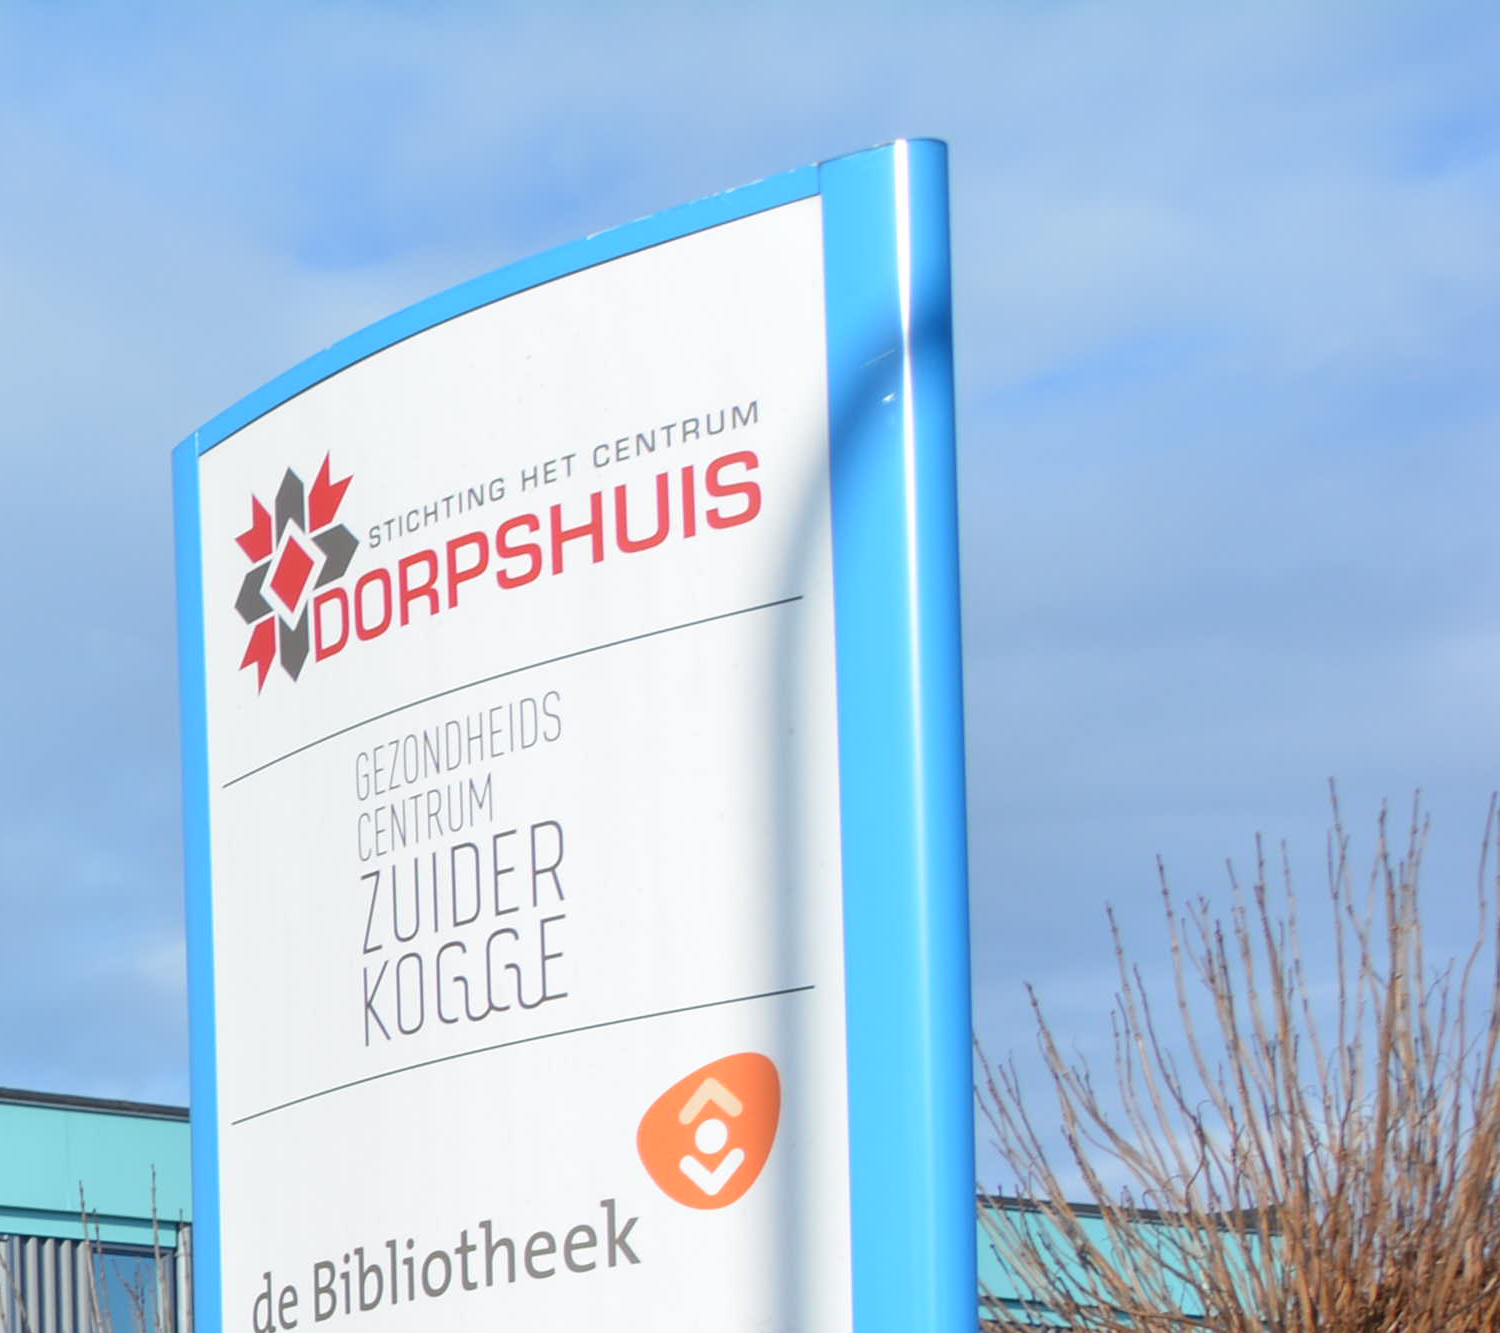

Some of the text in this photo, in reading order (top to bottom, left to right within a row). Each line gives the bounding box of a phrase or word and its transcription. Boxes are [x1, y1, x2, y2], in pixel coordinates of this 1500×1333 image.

[368, 400, 760, 549] STICHTING HET CENTRUM
[313, 449, 763, 662] DORPSHUIS
[355, 690, 563, 801] GEZONDHEIDS
[357, 773, 495, 862] CENTRUM
[360, 820, 566, 955] ZUIDER
[364, 914, 569, 1047] KOGGE
[313, 1198, 642, 1325] Bibliotheek
